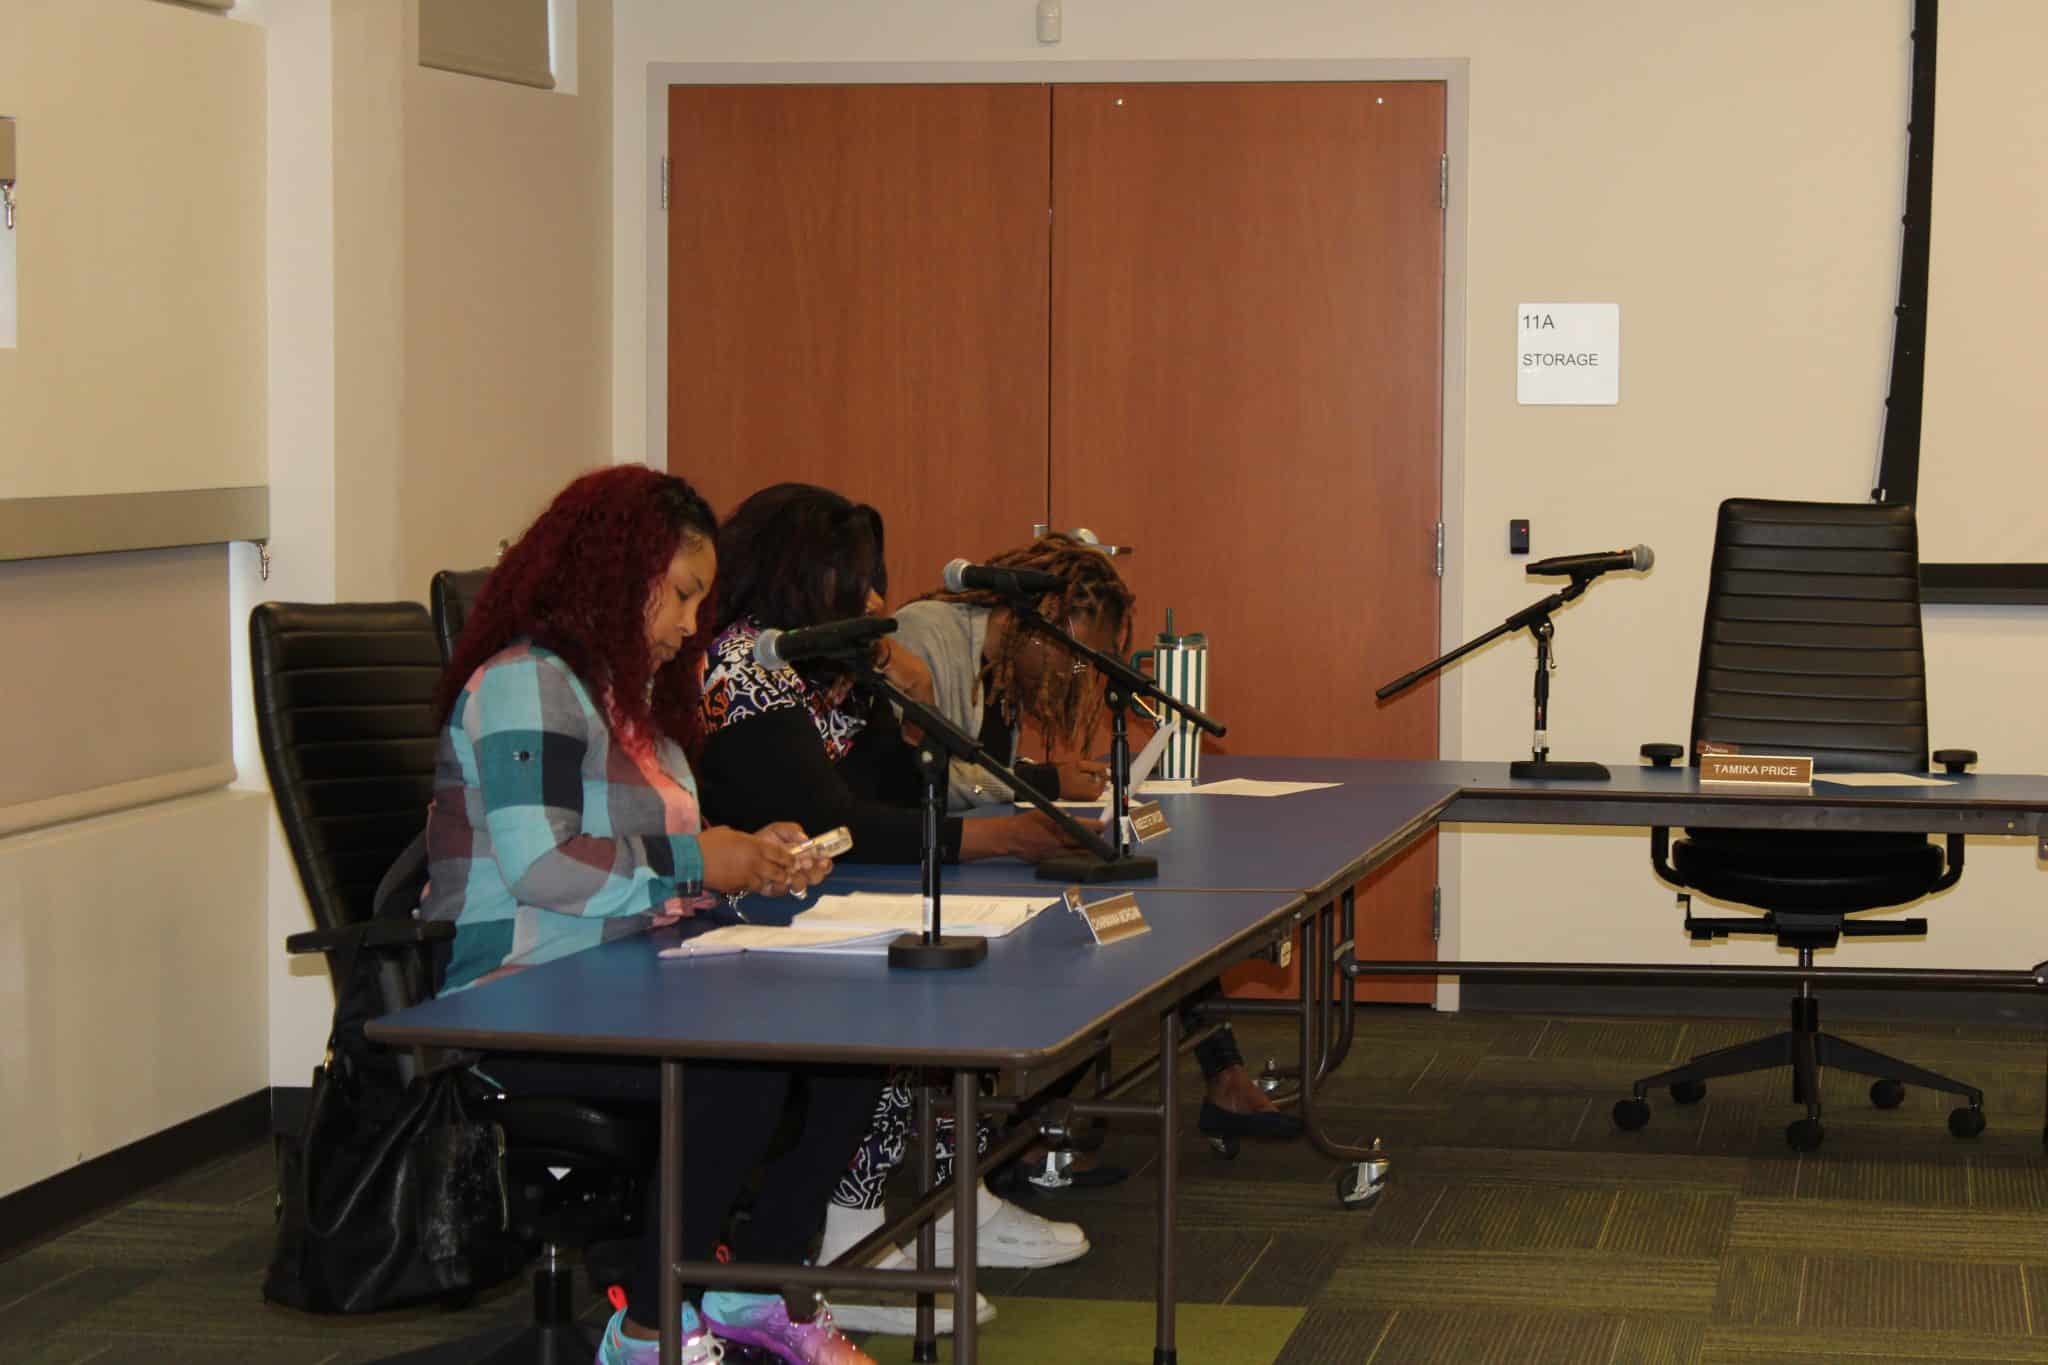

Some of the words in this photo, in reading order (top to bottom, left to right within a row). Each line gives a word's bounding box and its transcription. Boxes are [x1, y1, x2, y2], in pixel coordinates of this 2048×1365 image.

[1523, 314, 1555, 329] 11A
[1522, 353, 1600, 367] STORAGE
[1713, 764, 1759, 776] TAMIKA
[1761, 766, 1799, 776] PRICE
